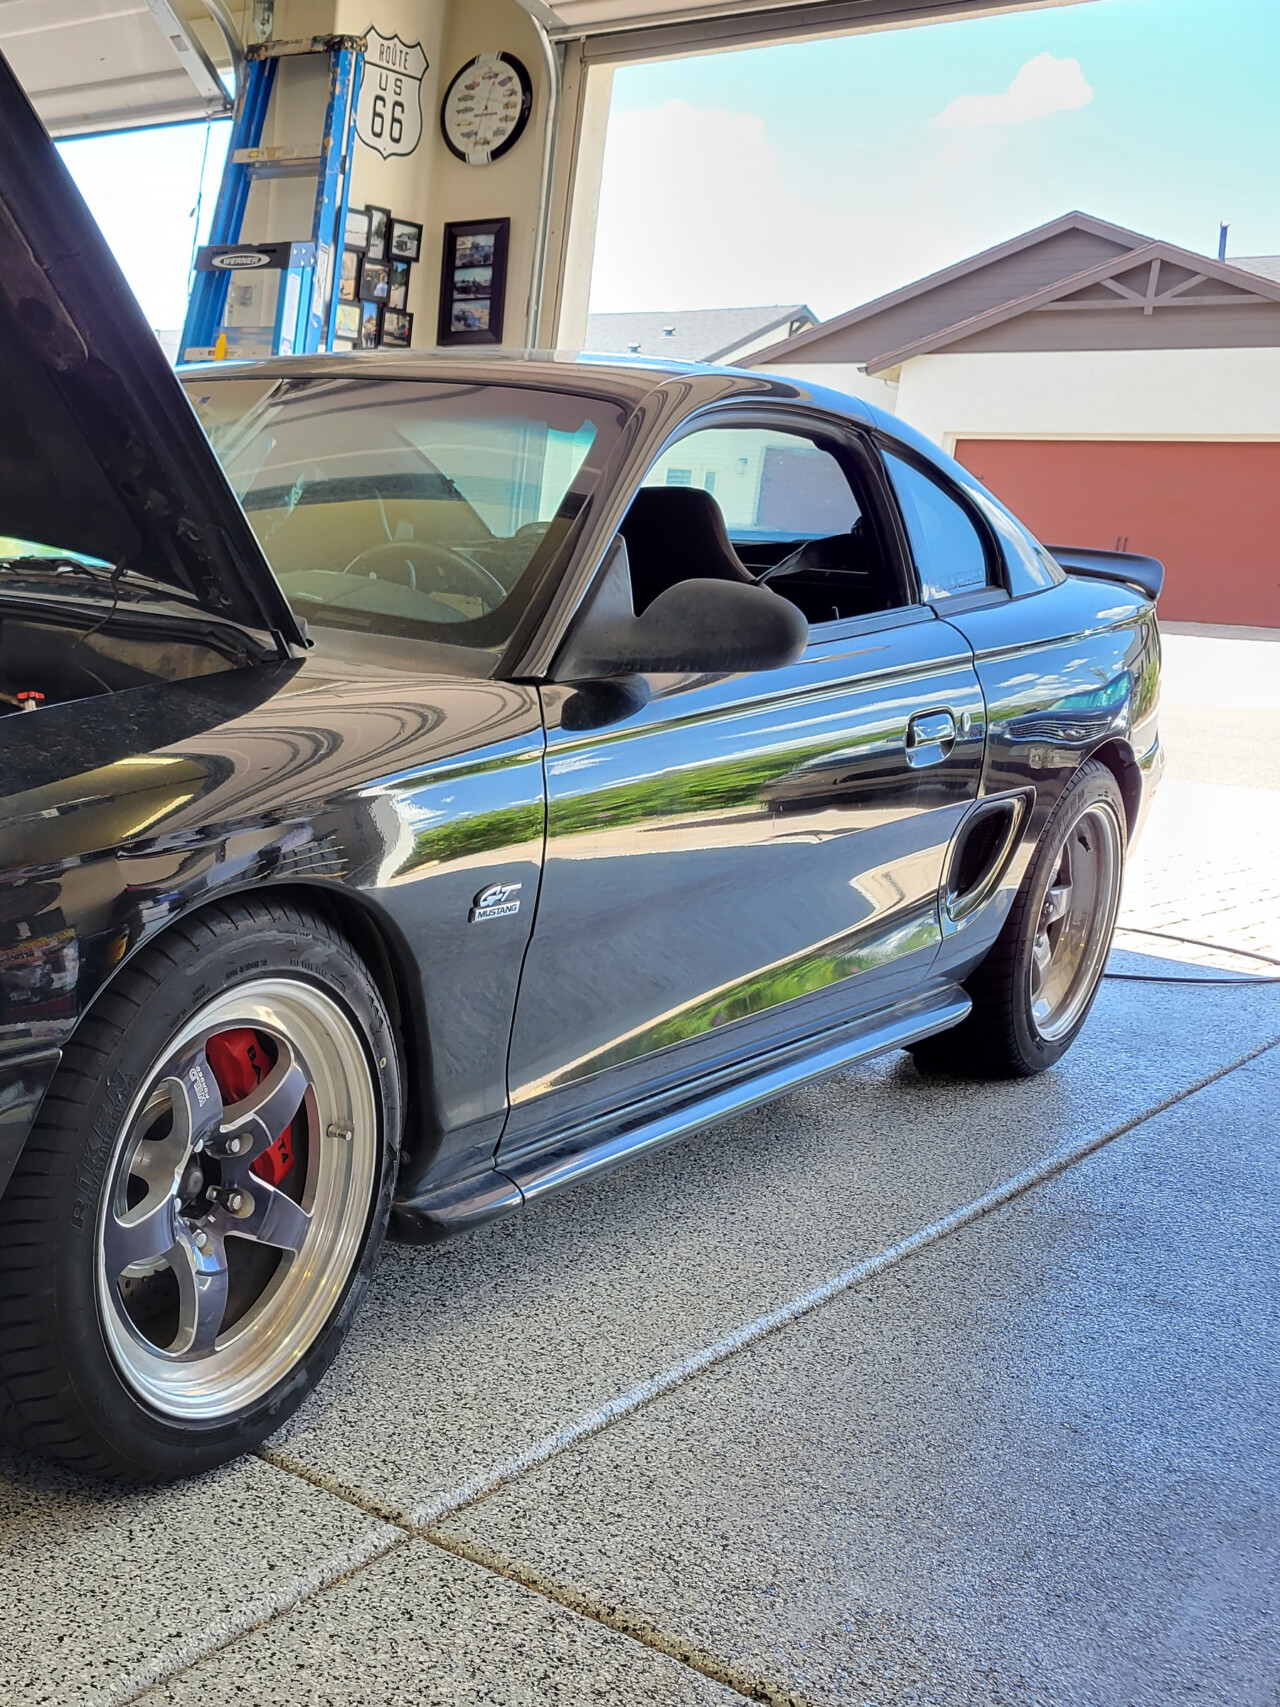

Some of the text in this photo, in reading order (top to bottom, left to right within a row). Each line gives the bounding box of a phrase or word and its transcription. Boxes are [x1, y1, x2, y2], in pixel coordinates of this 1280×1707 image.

[378, 43, 410, 70] ROUTE
[378, 72, 403, 96] US
[370, 94, 405, 144] 66
[223, 256, 259, 266] WERNER
[479, 883, 522, 908] GT
[477, 904, 518, 919] MUSTANG
[188, 1068, 208, 1108] WELD
[70, 1068, 127, 1231] RIKEN
